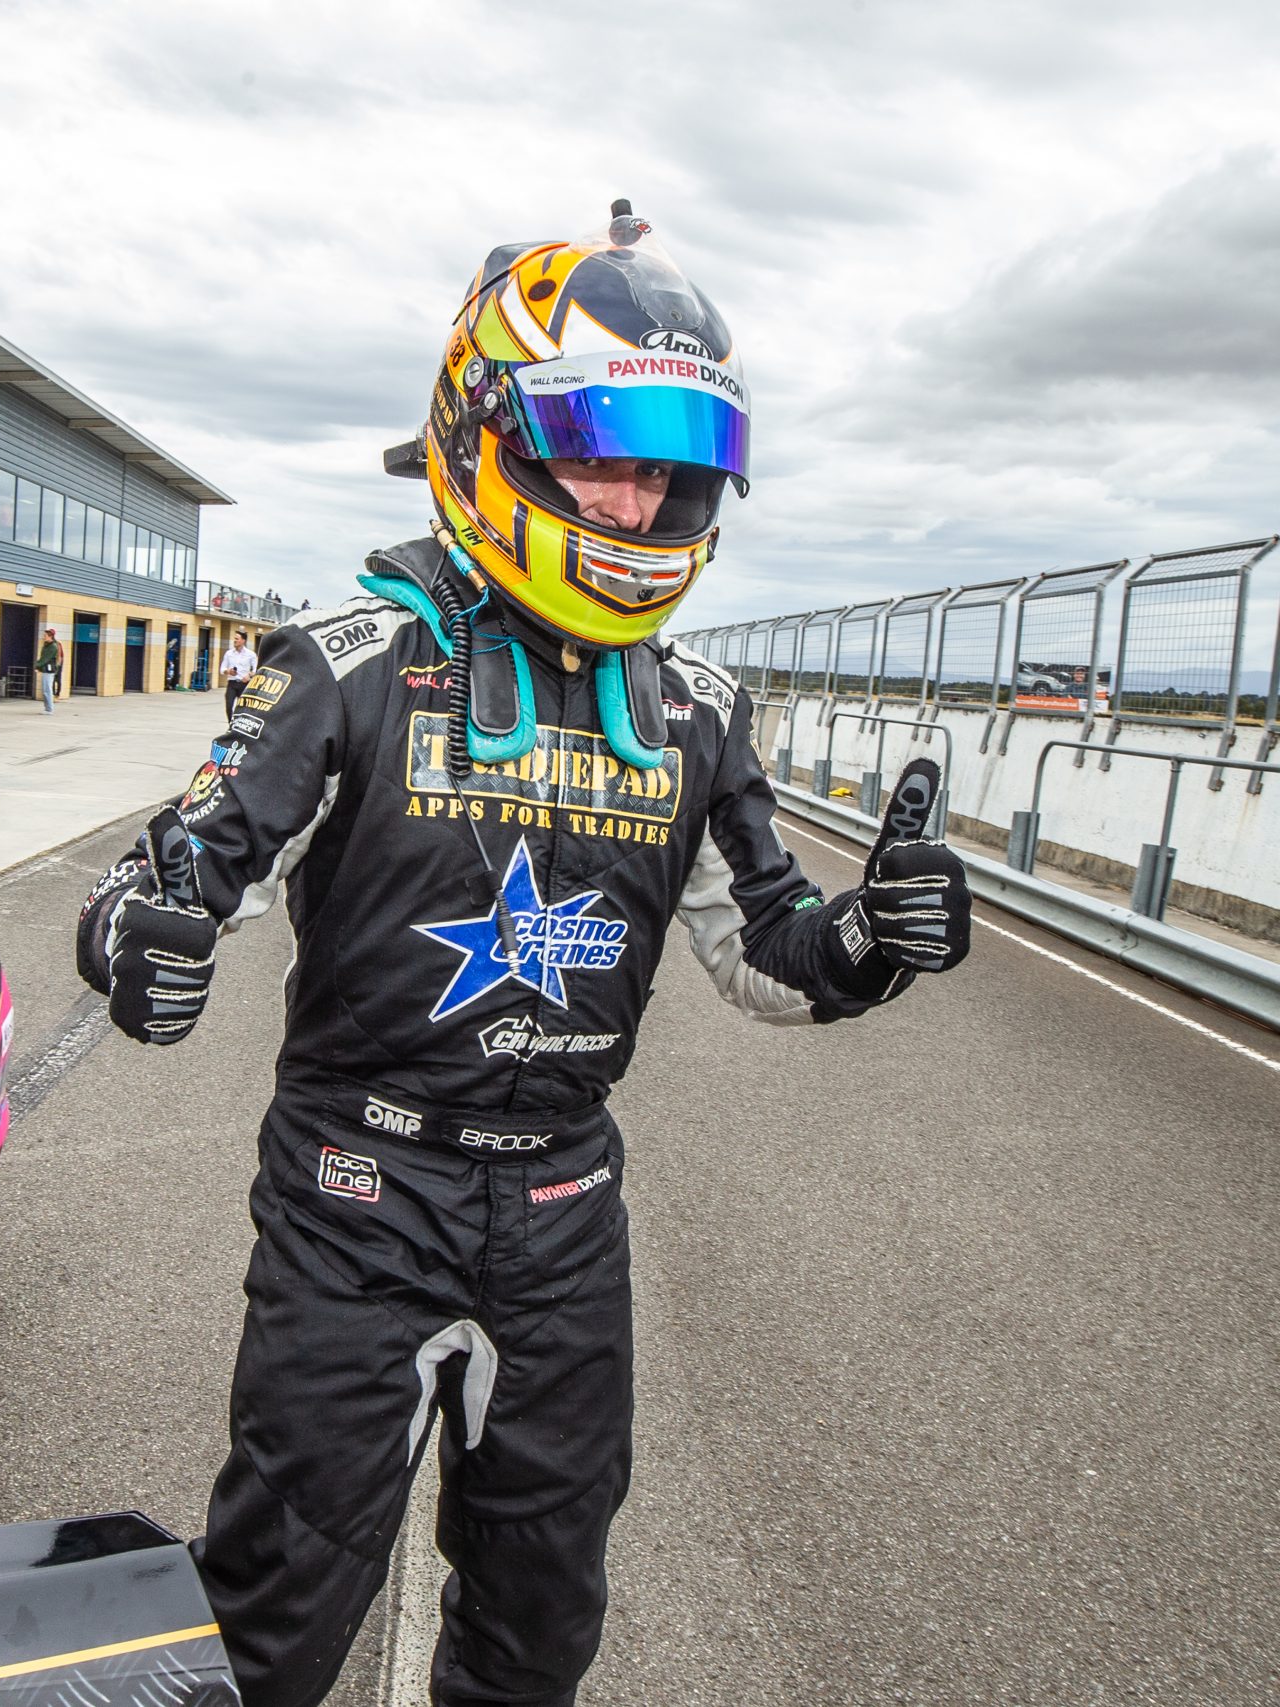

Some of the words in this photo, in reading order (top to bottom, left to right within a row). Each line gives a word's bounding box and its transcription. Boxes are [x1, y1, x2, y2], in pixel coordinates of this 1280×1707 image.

[646, 332, 706, 359] Arai
[530, 376, 551, 387] WALL
[552, 375, 585, 386] RACING
[461, 525, 485, 546] TIM
[325, 621, 378, 654] OMP
[406, 673, 440, 689] WALL
[423, 734, 671, 800] TADIEPAD
[405, 796, 485, 822] APPS
[500, 802, 553, 829] FOR
[569, 814, 670, 847] TRADIES
[364, 1104, 422, 1136] OMP
[459, 1128, 554, 1151] BROOK
[327, 1154, 373, 1173] race
[325, 1165, 373, 1190] line
